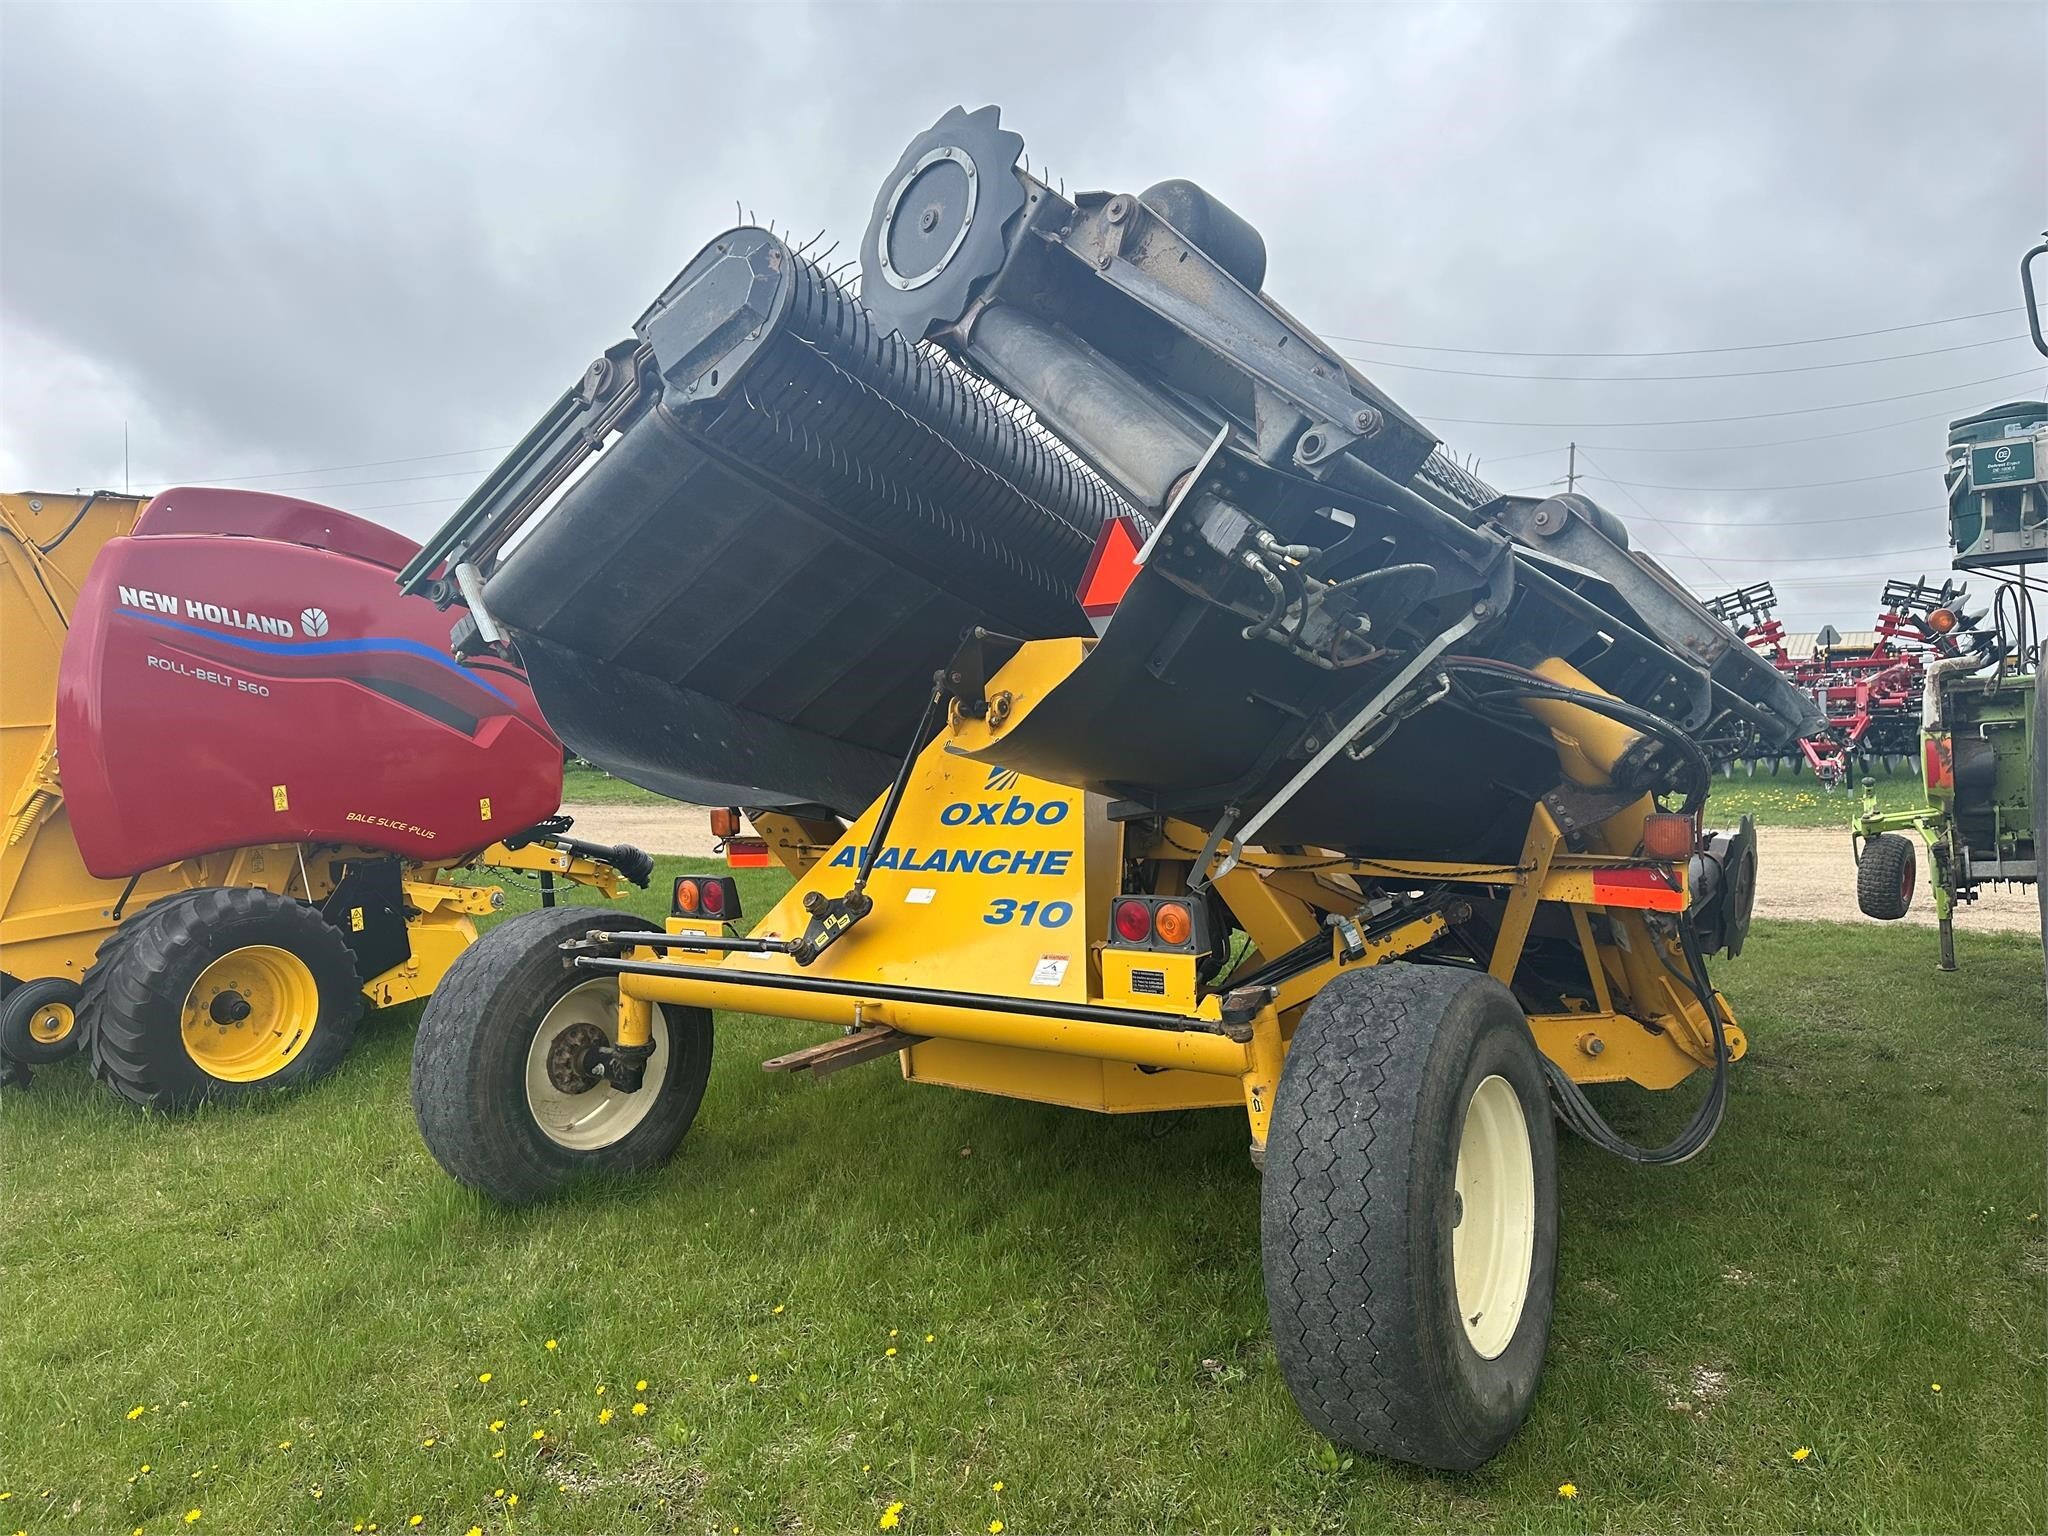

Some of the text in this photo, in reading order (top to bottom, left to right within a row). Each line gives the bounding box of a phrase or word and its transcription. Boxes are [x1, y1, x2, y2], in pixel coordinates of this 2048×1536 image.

[118, 585, 294, 638] NEW HOLLAND
[147, 655, 270, 697] ROLL-BELT 560
[346, 812, 377, 824] BALE
[376, 817, 408, 831] SLICE
[940, 795, 1070, 826] oxbo
[983, 898, 1074, 929] 310
